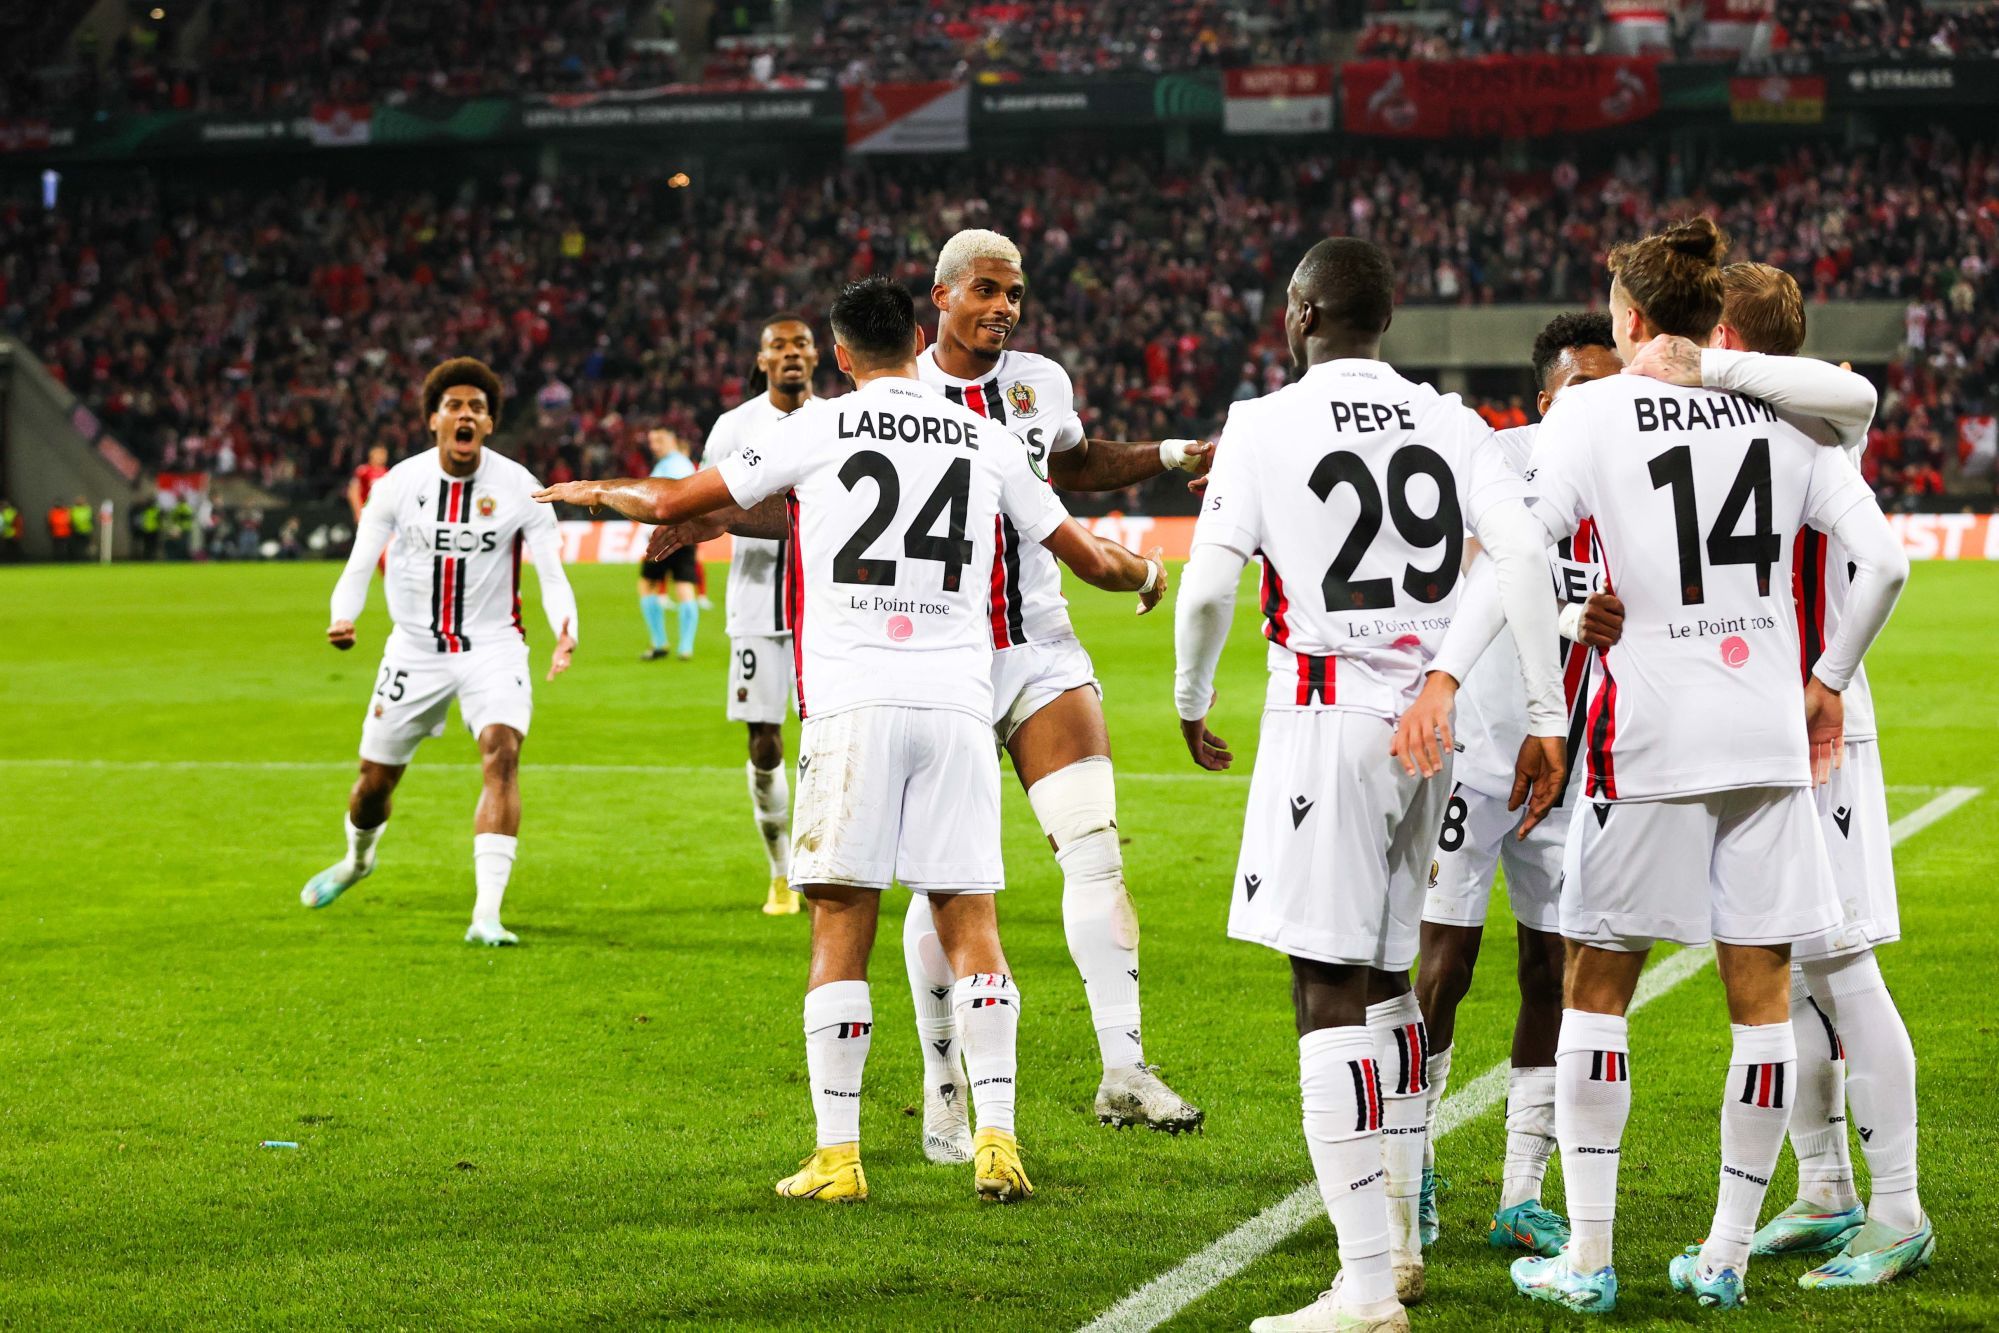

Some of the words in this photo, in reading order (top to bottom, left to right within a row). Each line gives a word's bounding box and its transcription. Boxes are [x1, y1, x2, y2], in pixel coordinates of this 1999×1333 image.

[838, 410, 979, 451] LABORDE
[833, 450, 974, 593] 24
[1308, 444, 1464, 612] 29
[1647, 438, 1781, 606] 14
[850, 595, 868, 610] Le
[873, 596, 915, 613] Point
[919, 602, 950, 615] rose
[1348, 622, 1369, 638] Le
[1374, 619, 1419, 635] Point
[1668, 623, 1690, 639] Le
[1697, 616, 1746, 637] Point
[1751, 616, 1777, 631] ros
[377, 666, 409, 702] 25
[1350, 1174, 1375, 1191] OGC
